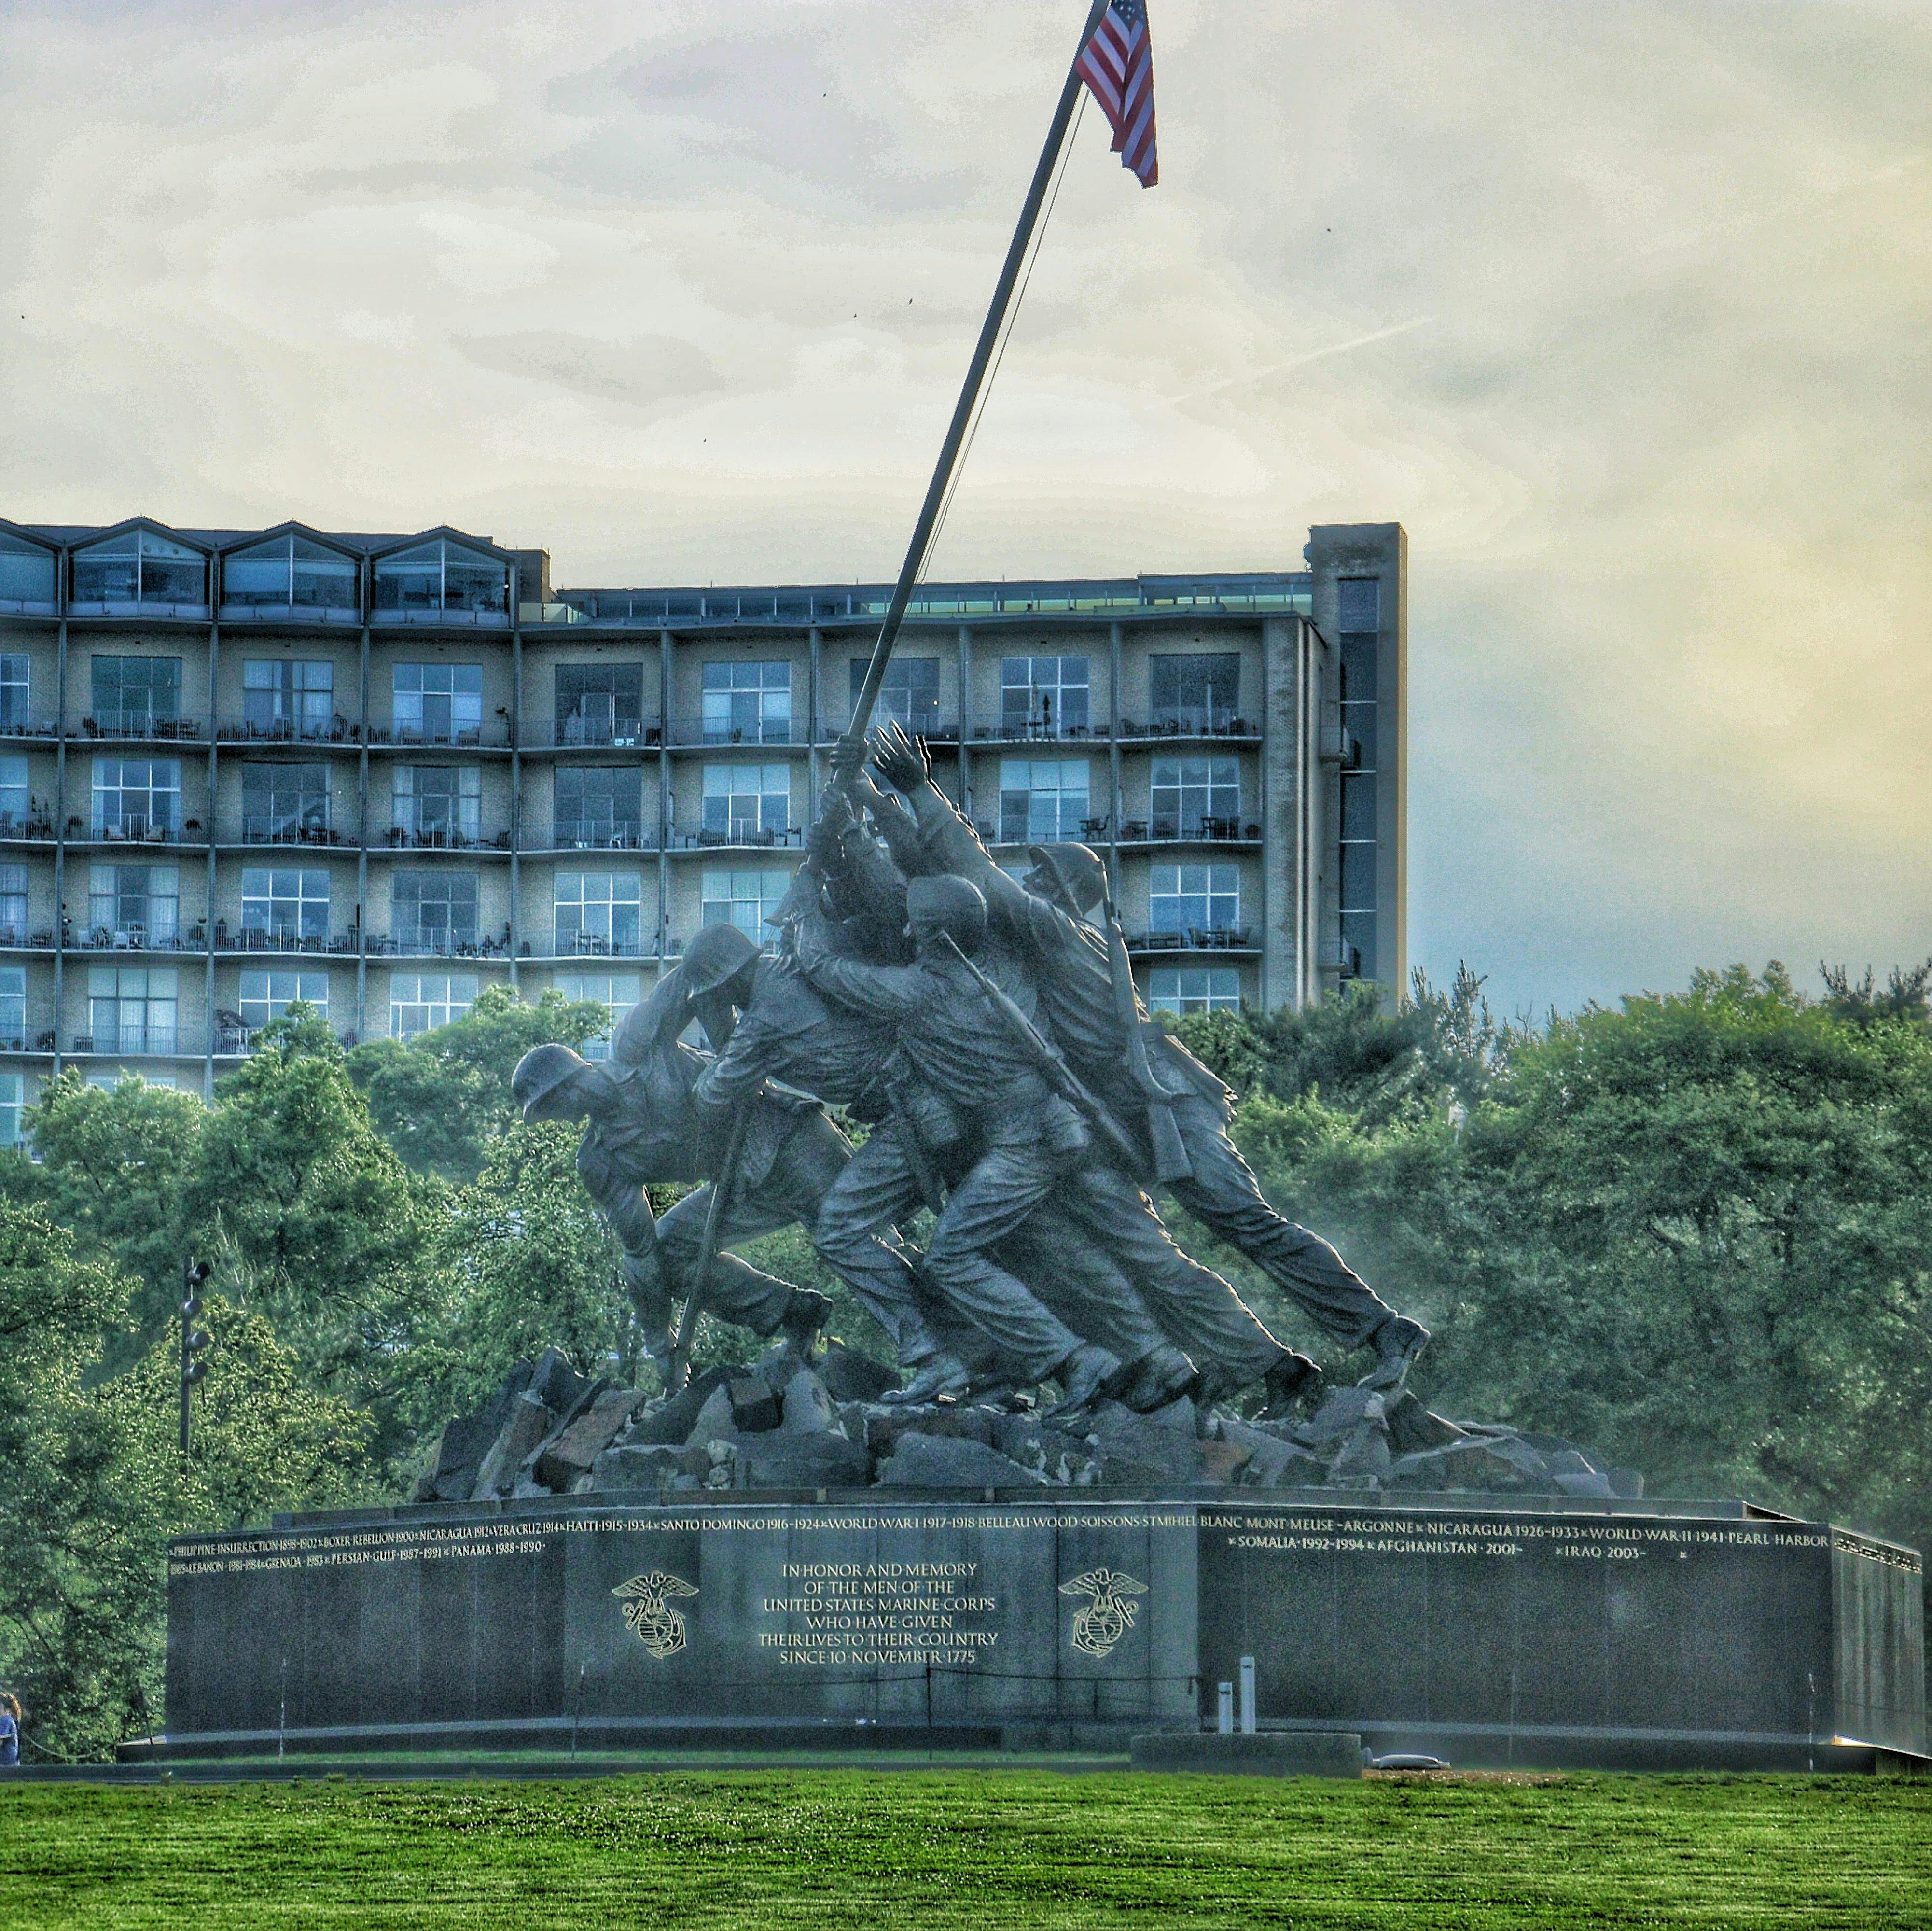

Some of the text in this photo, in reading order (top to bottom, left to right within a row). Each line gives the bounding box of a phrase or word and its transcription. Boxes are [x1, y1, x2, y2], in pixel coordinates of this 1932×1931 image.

[217, 1539, 278, 1554] INSURRECTION
[324, 1535, 351, 1548] BOXER
[353, 1532, 394, 1546] REBELLION
[396, 1531, 415, 1543] 1900
[419, 1526, 473, 1541] NICARAGUA
[493, 1524, 515, 1537] VERA
[516, 1523, 542, 1535] CRUZ
[543, 1522, 559, 1533] 1914
[567, 1520, 598, 1532] HAITI
[602, 1520, 652, 1532] 1915-1934
[661, 1519, 700, 1531] SANTO
[703, 1519, 765, 1530] DOMINGO
[767, 1519, 819, 1530] 1916-1924
[828, 1518, 878, 1529] WORLD
[881, 1518, 914, 1529] WAR
[915, 1518, 919, 1529] I
[923, 1517, 975, 1529] 1917-1918
[979, 1517, 1030, 1528] BELLEAU
[1033, 1516, 1078, 1528] WOOD
[1081, 1516, 1139, 1527] SOISSONS
[1200, 1515, 1242, 1529] BLANC
[1246, 1517, 1286, 1530] MONT
[1427, 1522, 1512, 1537] NICARAGUA
[1516, 1525, 1579, 1539] 1926-1933
[1589, 1527, 1642, 1540] WORLD
[1645, 1529, 1680, 1542] WAR
[1696, 1531, 1723, 1543] 1941
[1729, 1532, 1770, 1545] PEARL
[1775, 1534, 1828, 1547] HARBOR
[1238, 1536, 1297, 1549] SOMALIA
[1303, 1537, 1364, 1551] 1992-1994
[1377, 1539, 1477, 1553] AFGHANISTAN
[1565, 1546, 1602, 1558] IRAQ
[265, 1557, 302, 1569] GRENADA
[331, 1551, 370, 1565] PERSIAN
[373, 1549, 397, 1562] GULF
[451, 1543, 492, 1557] PANAMA
[783, 1563, 977, 1577] IN HONOR AND MEMORY
[804, 1580, 955, 1594] OF THE MEN OF THE
[764, 1597, 995, 1612] UNITED STATES MARINE CORPS
[806, 1615, 952, 1629] WHO HAVE GIVEN
[758, 1632, 998, 1647] THEIR LIVES TO THEIR COUNTRY
[780, 1651, 826, 1664] SINCE
[830, 1651, 846, 1664] 10
[947, 1650, 975, 1664] 1775
